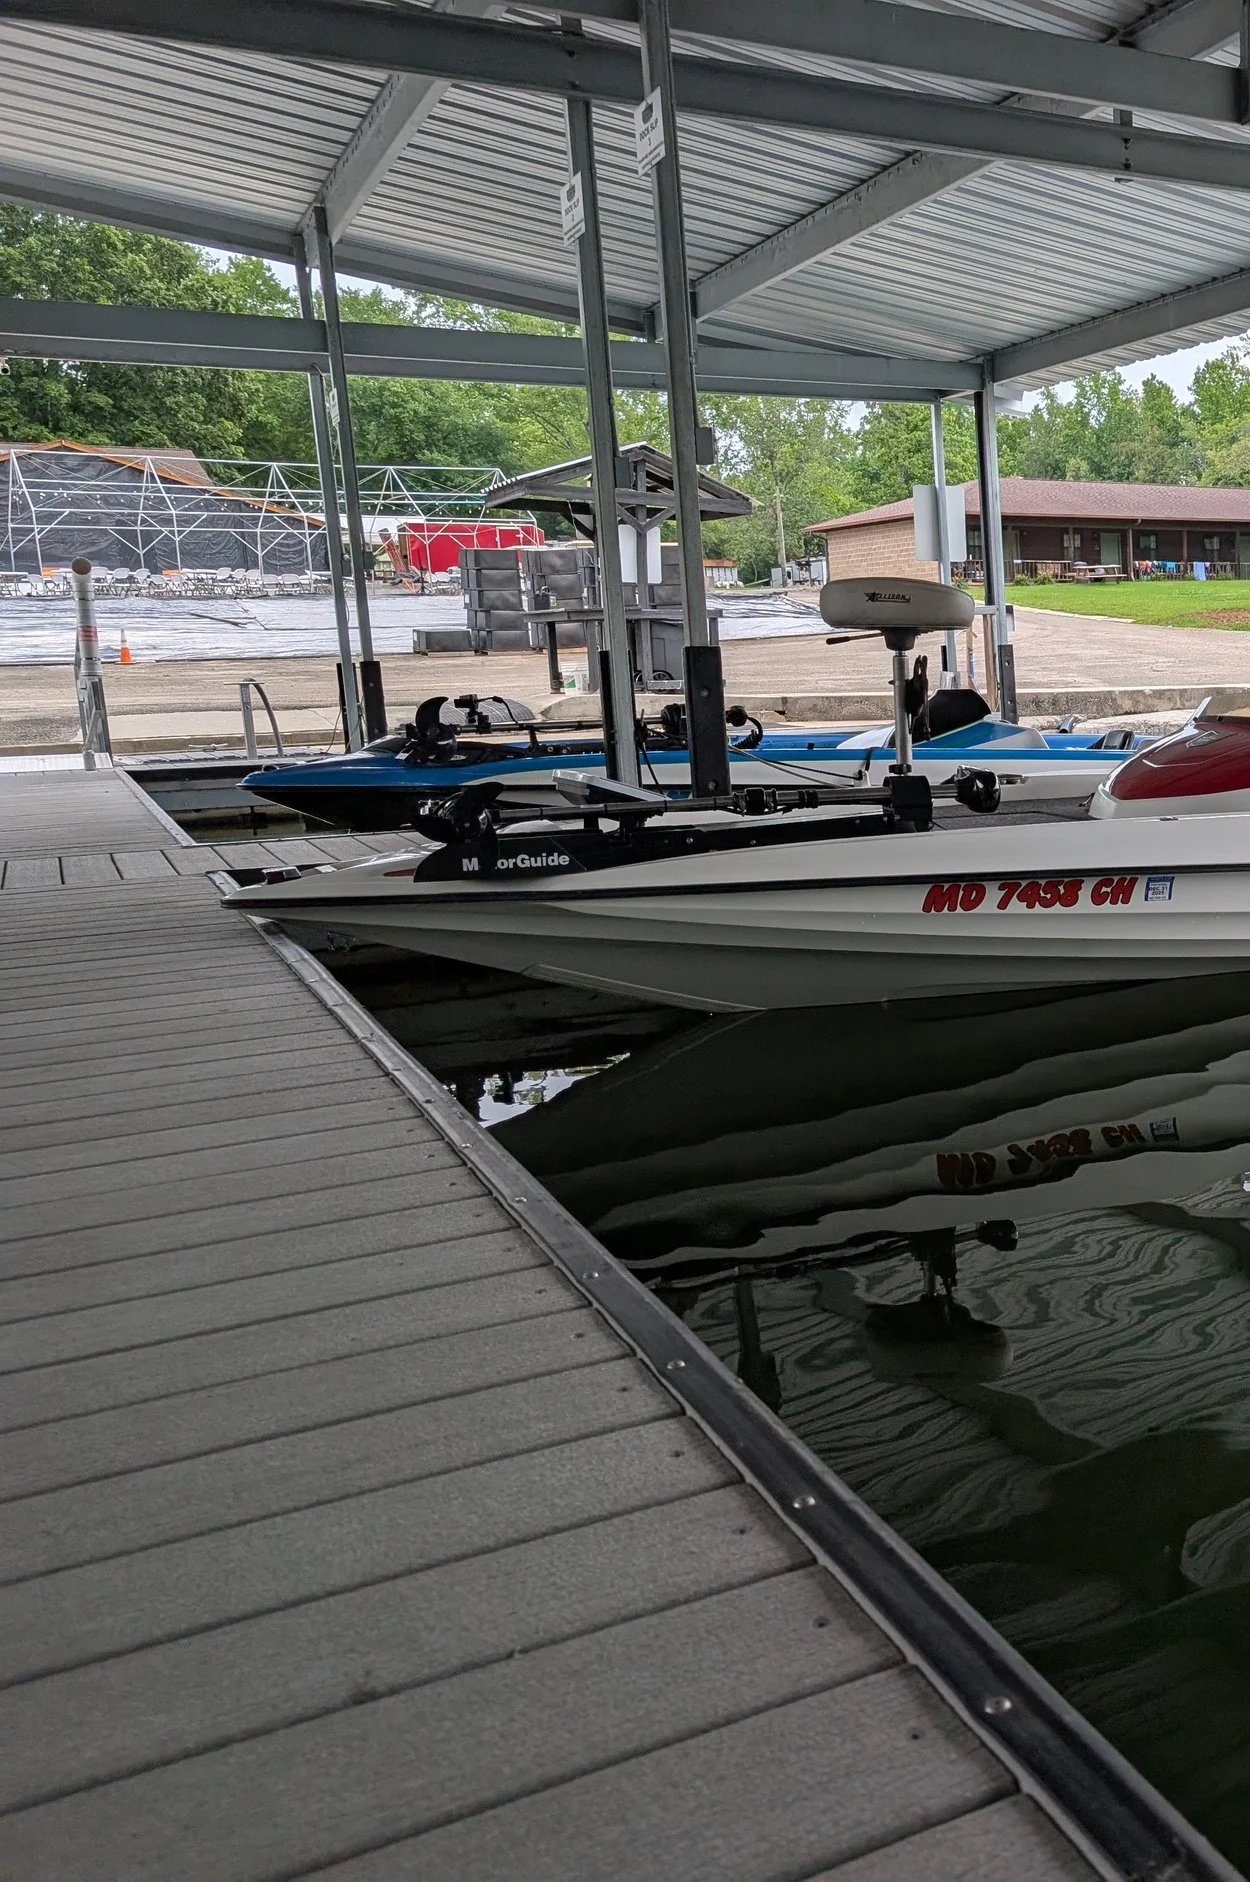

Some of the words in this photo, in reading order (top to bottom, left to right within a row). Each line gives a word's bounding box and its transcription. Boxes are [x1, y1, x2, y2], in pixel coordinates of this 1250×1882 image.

[462, 852, 570, 872] MorGuide
[922, 883, 986, 913] MD
[996, 878, 1084, 910] 7458
[1090, 876, 1138, 906] CH
